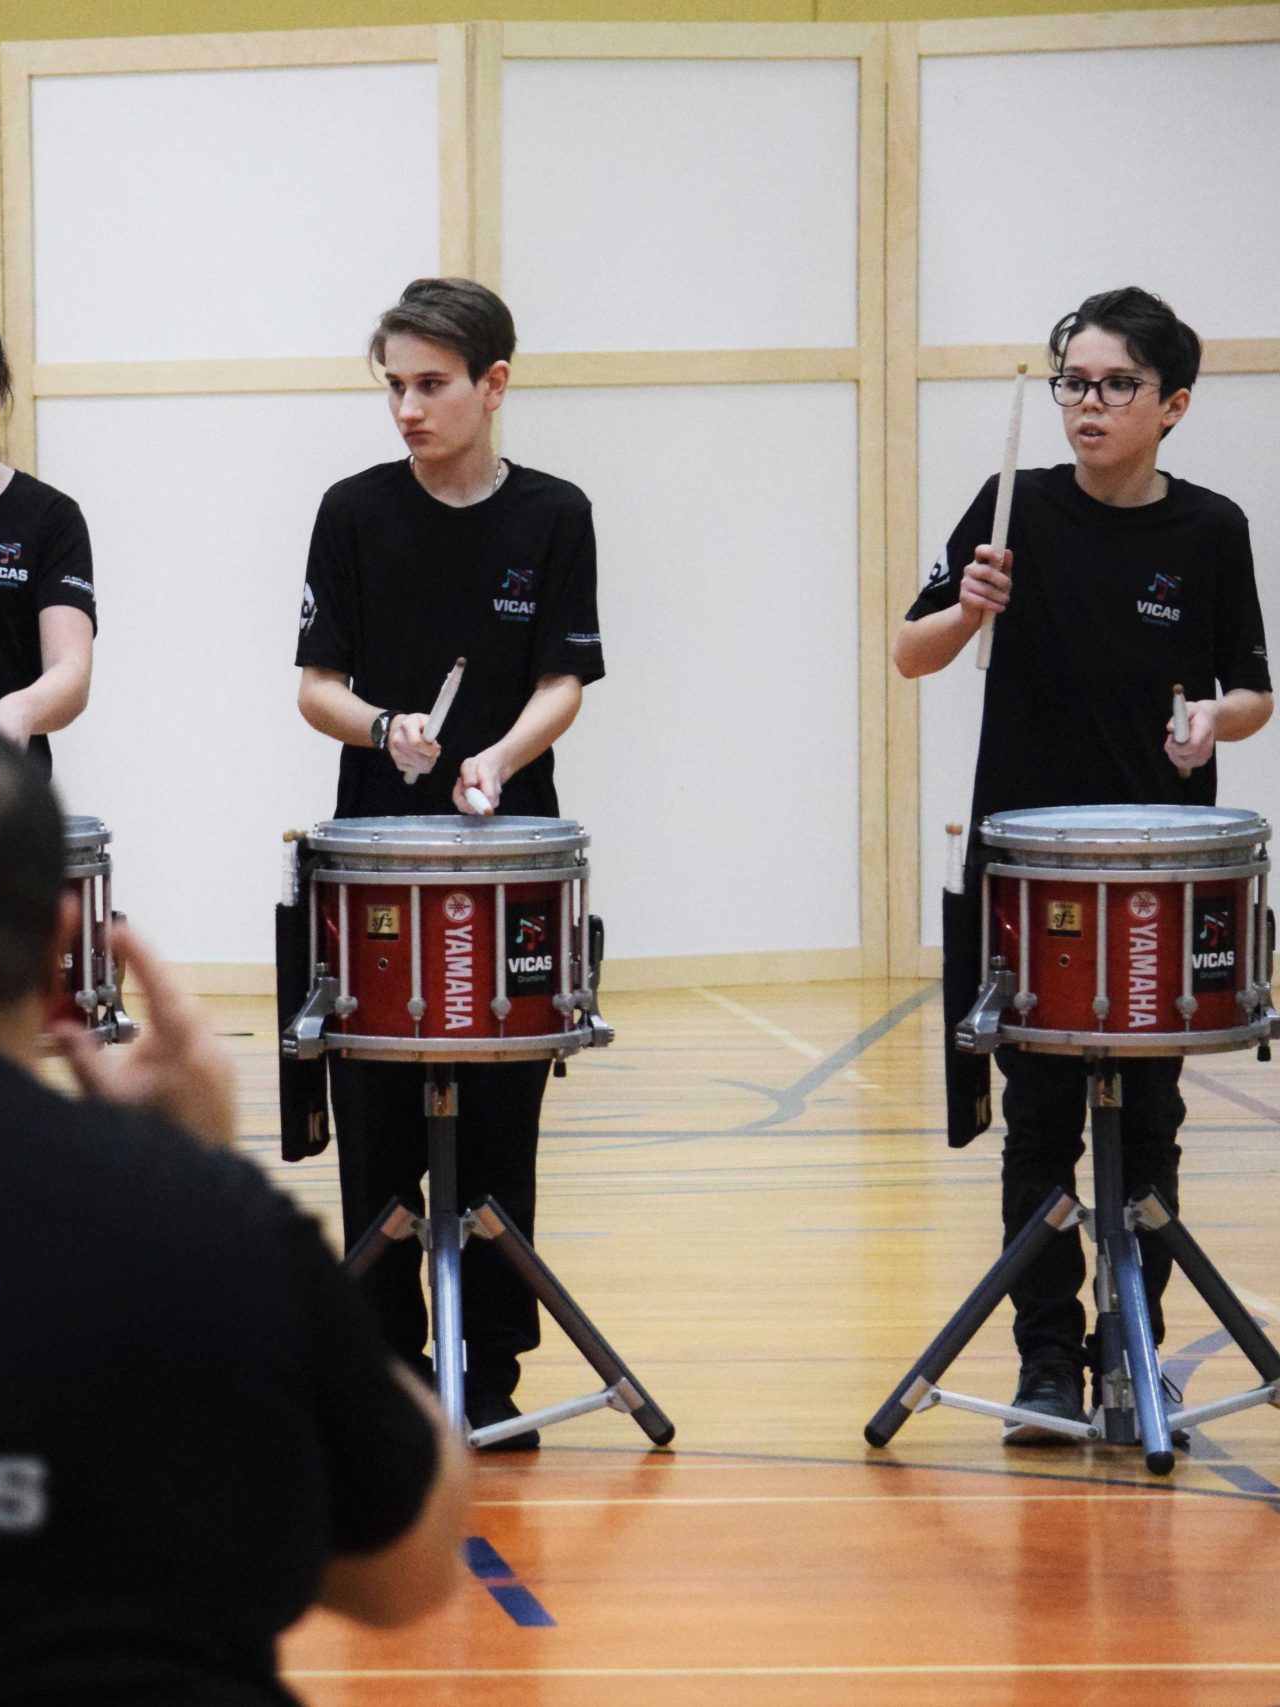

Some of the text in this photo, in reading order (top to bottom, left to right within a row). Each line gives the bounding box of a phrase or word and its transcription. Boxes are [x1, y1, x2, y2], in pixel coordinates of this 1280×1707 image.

[493, 599, 537, 615] VICAS
[1137, 600, 1181, 622] VICAS
[508, 955, 553, 973] VICAS
[1192, 950, 1235, 969] VICAS
[444, 924, 474, 1031] YAMAHA
[1128, 922, 1159, 1030] YAMAHA
